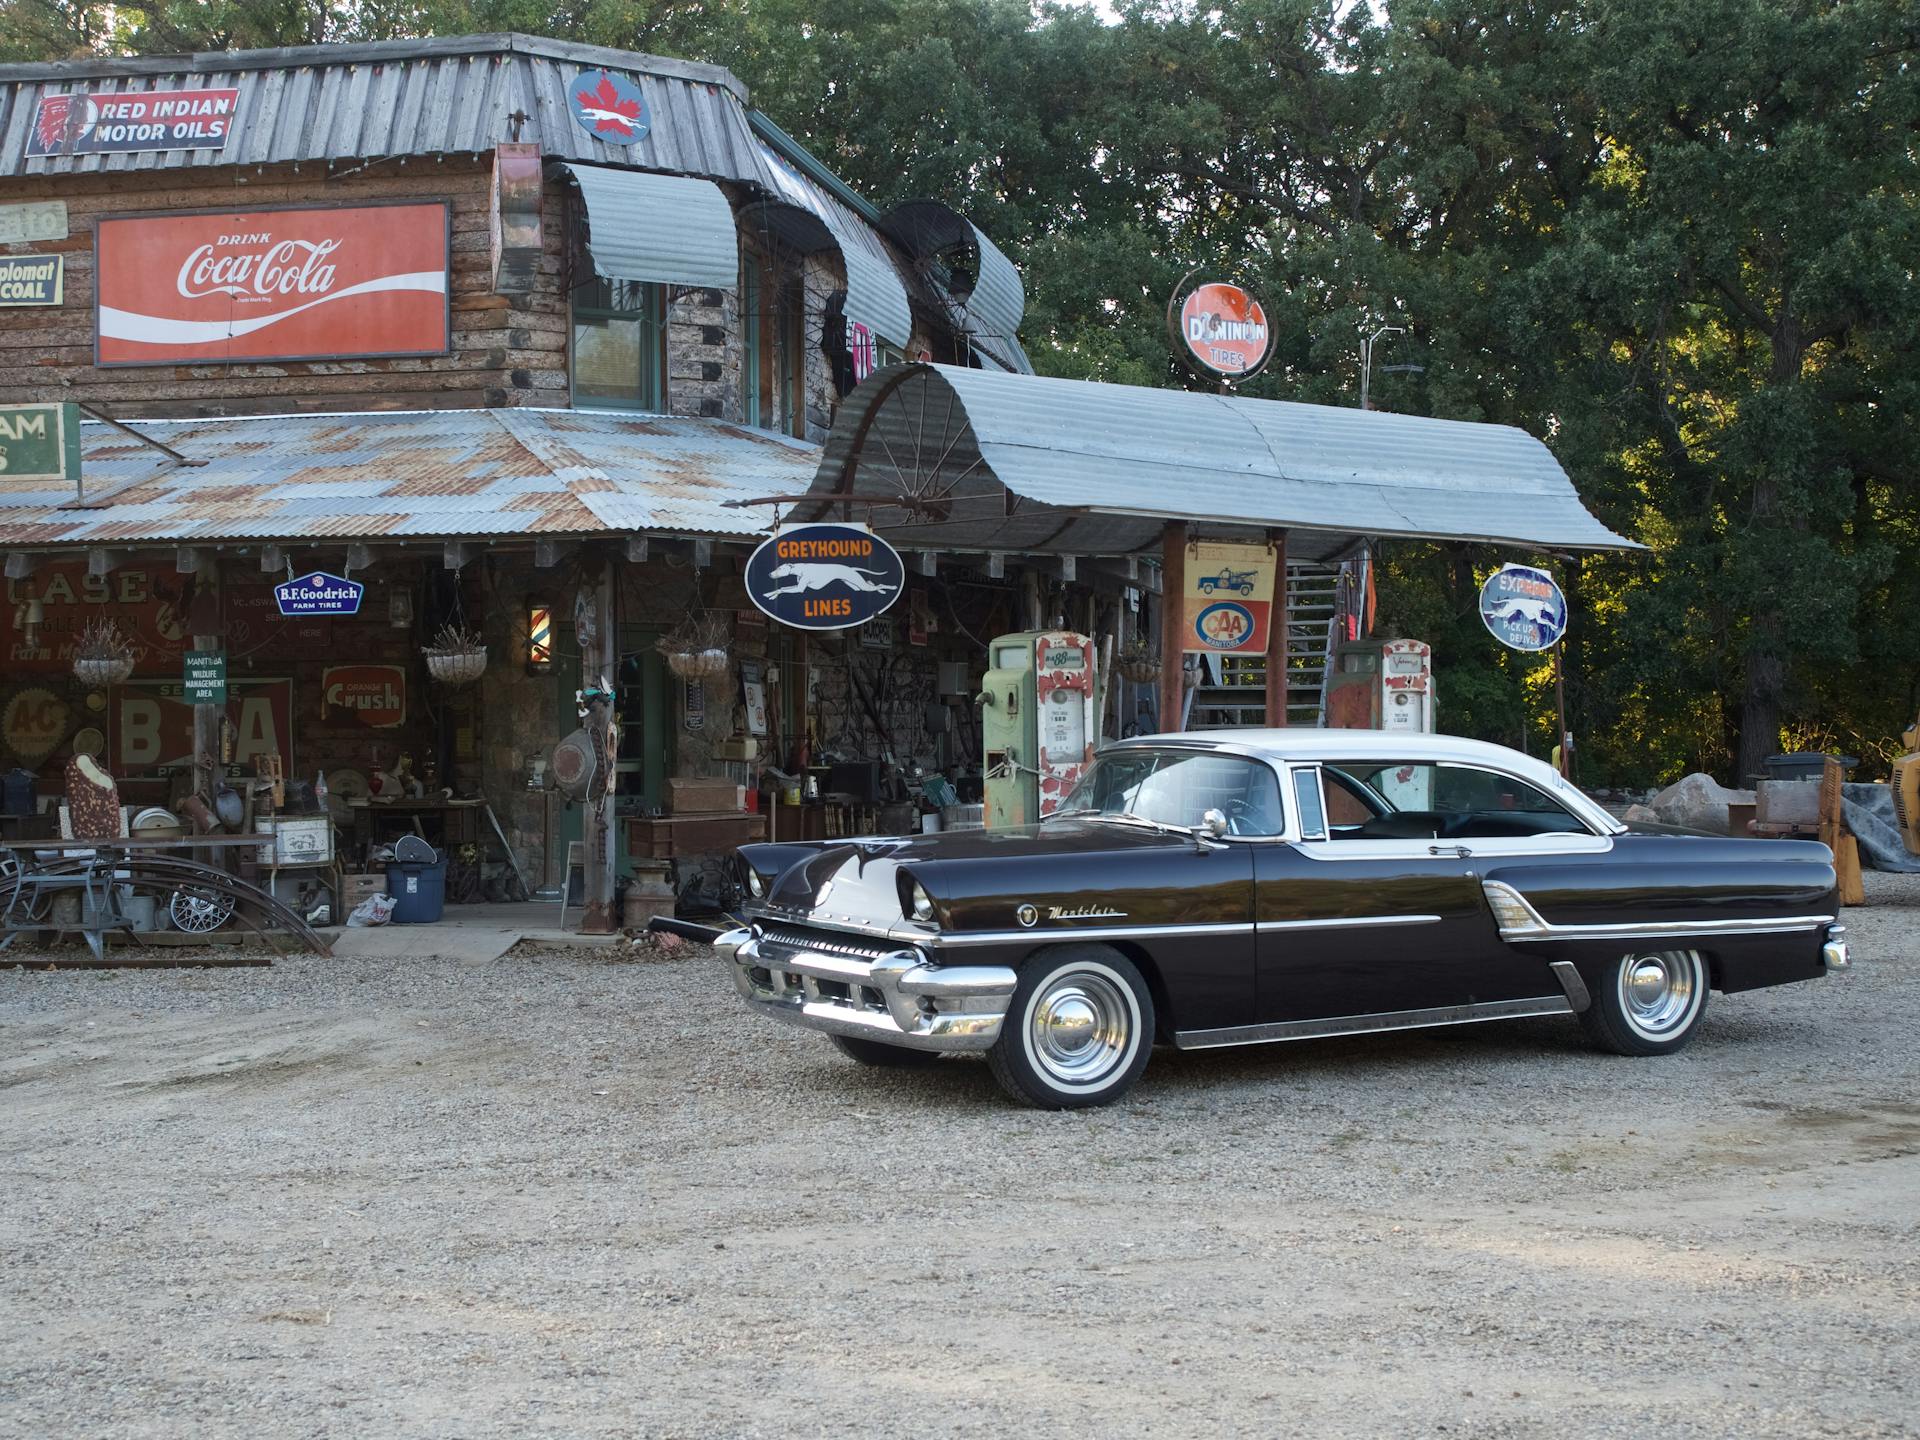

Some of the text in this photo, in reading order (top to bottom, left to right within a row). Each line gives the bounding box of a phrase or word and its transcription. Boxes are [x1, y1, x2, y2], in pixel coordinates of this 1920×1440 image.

[101, 99, 230, 119] RED INDIAN
[94, 120, 225, 142] MOTOR OILS
[216, 232, 272, 246] DRINK
[176, 238, 343, 298] Coca-Cola
[0, 282, 46, 299] COAL
[1189, 312, 1265, 345] DOMINION
[1209, 347, 1246, 368] TIRES
[777, 539, 873, 559] GREYHOUND
[804, 599, 852, 617] LINES
[1205, 611, 1243, 633] CAA
[185, 679, 225, 688] MANAGEMENT
[192, 669, 217, 679] WILDLIFE
[196, 689, 213, 699] AREA
[326, 683, 400, 710] Crush
